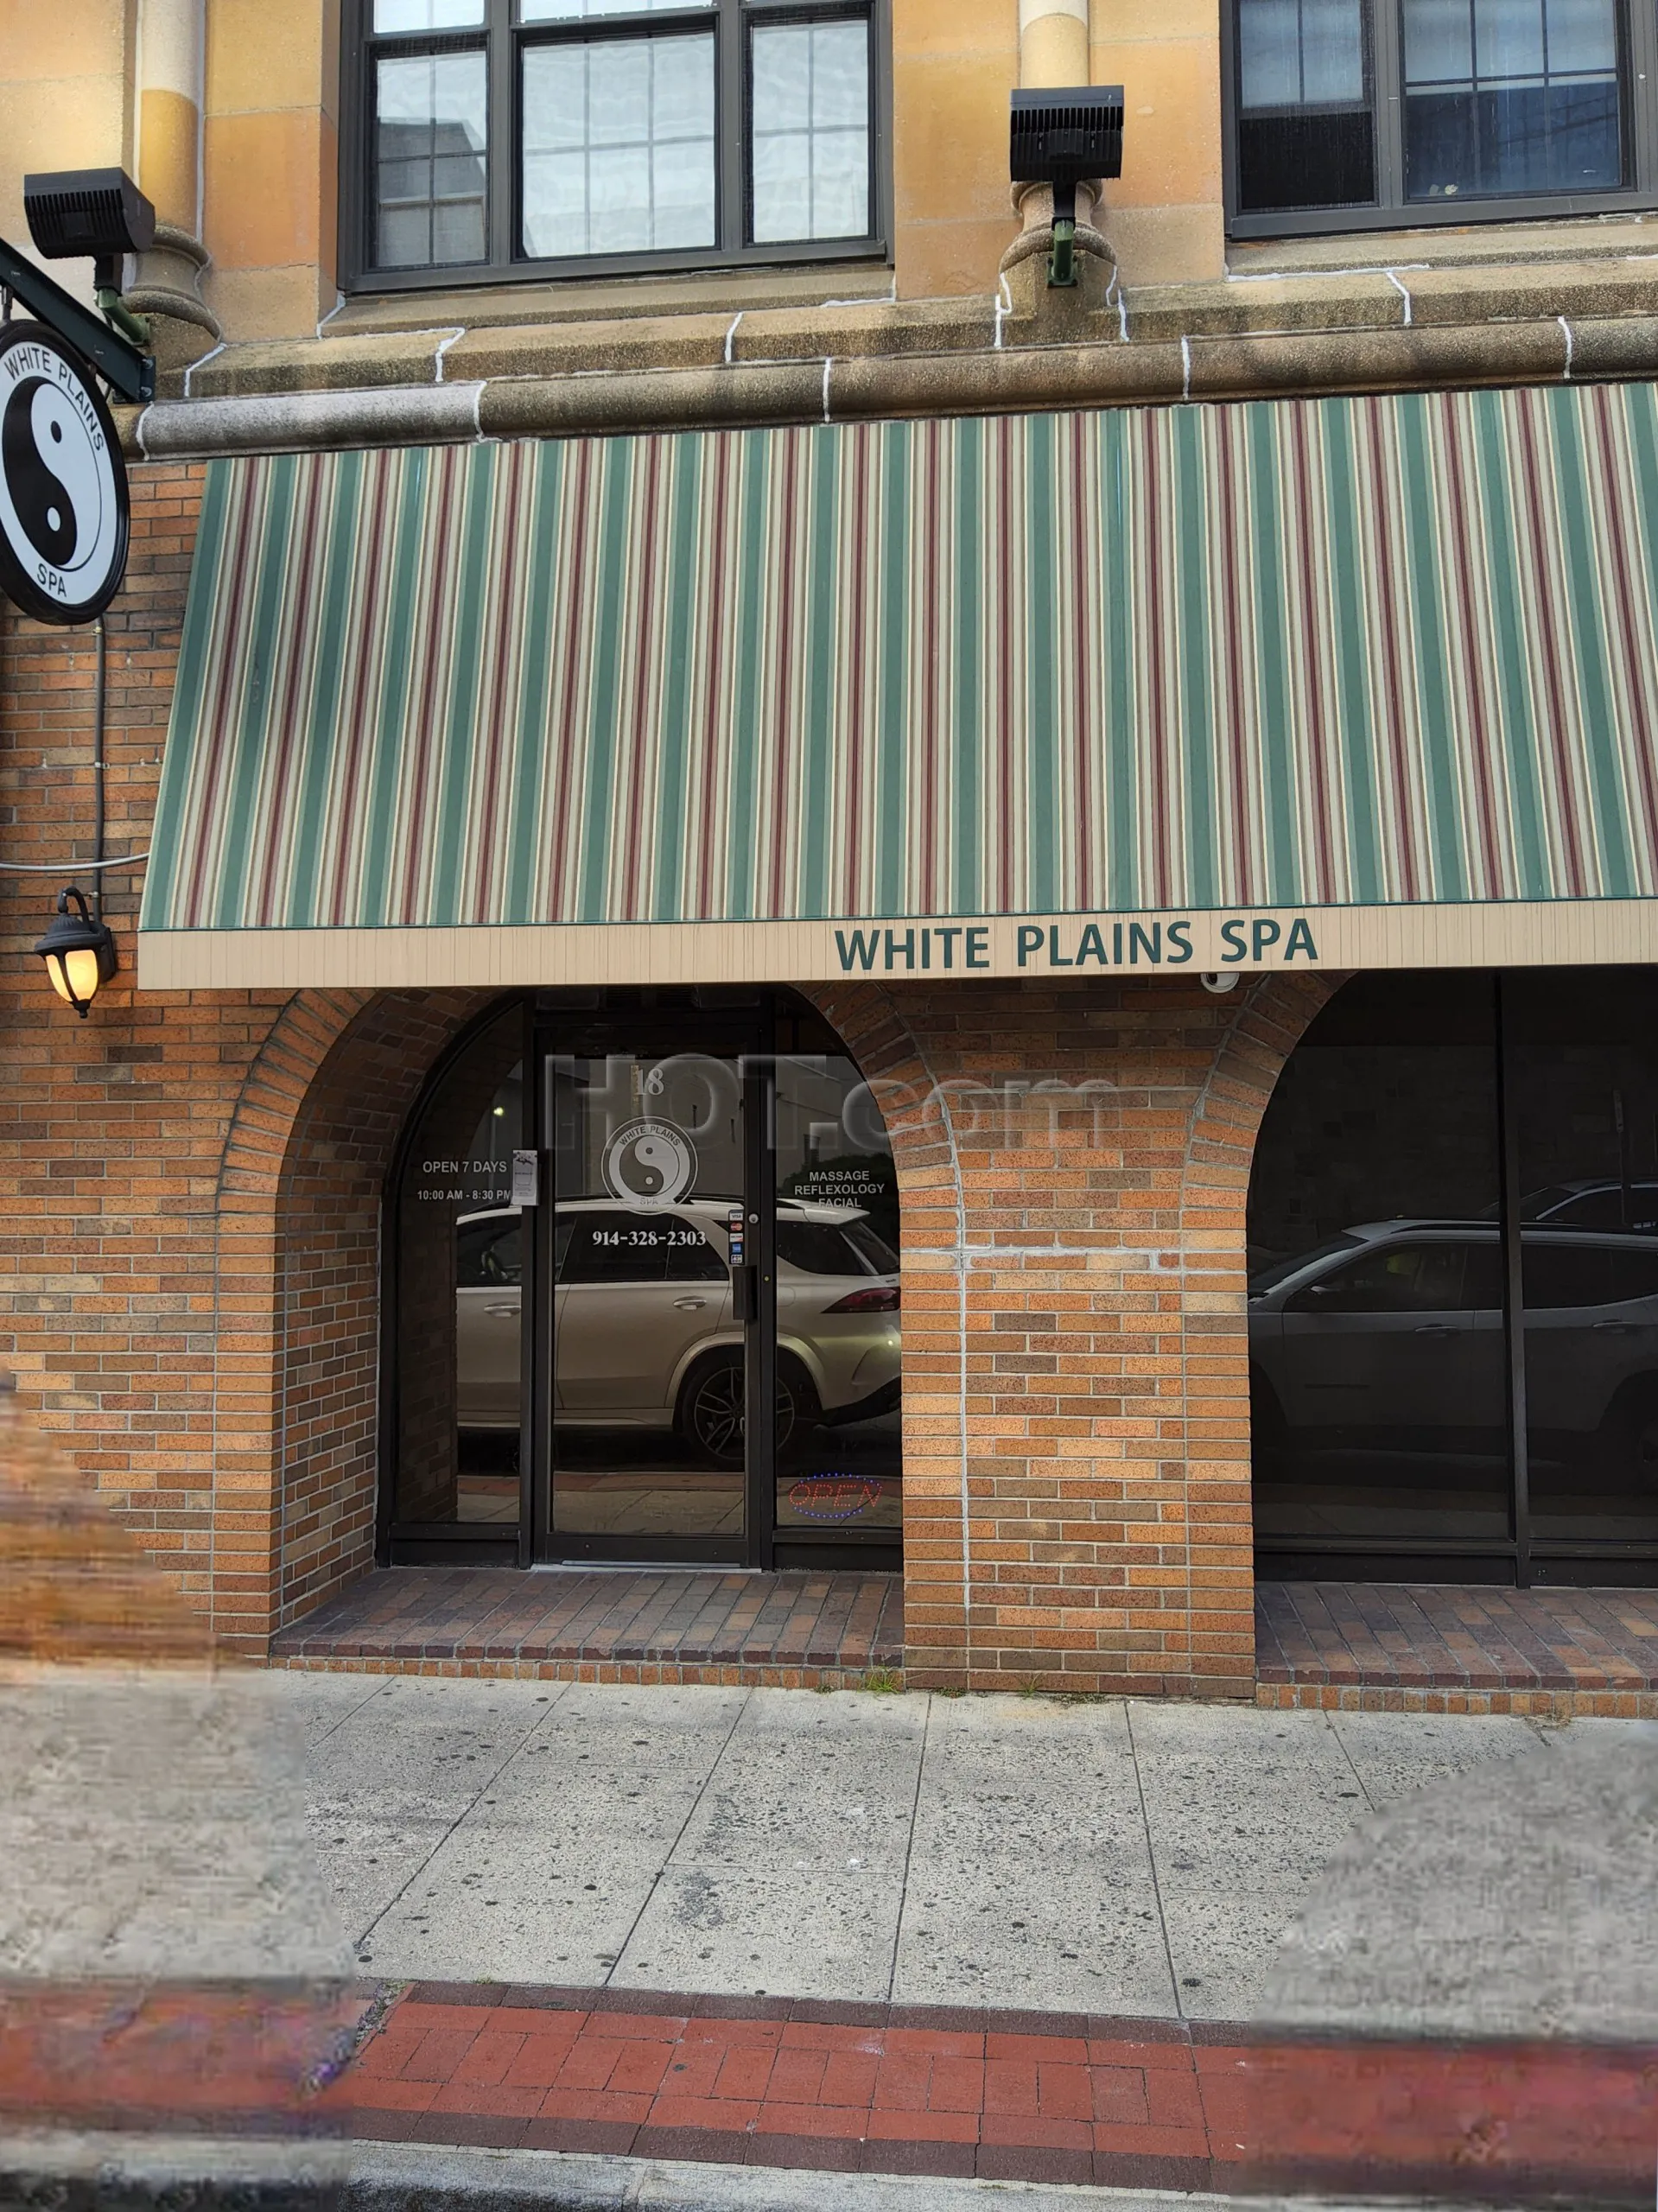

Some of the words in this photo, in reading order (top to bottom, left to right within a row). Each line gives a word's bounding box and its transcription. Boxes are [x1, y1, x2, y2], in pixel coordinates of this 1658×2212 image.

[3, 346, 52, 380] WHITE
[58, 363, 104, 451] PLAINS
[36, 563, 67, 598] SPA
[834, 926, 990, 971] WHITE
[1017, 921, 1193, 967] PLAINS
[1220, 918, 1318, 963] SPA
[633, 1067, 664, 1096] 18
[619, 1125, 647, 1147] WHITE
[649, 1125, 682, 1147] PLAINS
[422, 1160, 459, 1173] OPEN
[462, 1160, 470, 1173] 7
[473, 1160, 508, 1173] DAYS
[809, 1170, 870, 1182] MASSAGE
[416, 1190, 444, 1200] 10:00
[446, 1190, 463, 1200] AM
[472, 1190, 493, 1200] 8:30
[496, 1190, 511, 1201] PM
[794, 1183, 886, 1196] REFLEXOLOGY
[818, 1197, 862, 1208] FACIAL
[592, 1230, 707, 1246] 914-328-2303
[787, 1483, 883, 1508] OPEN
